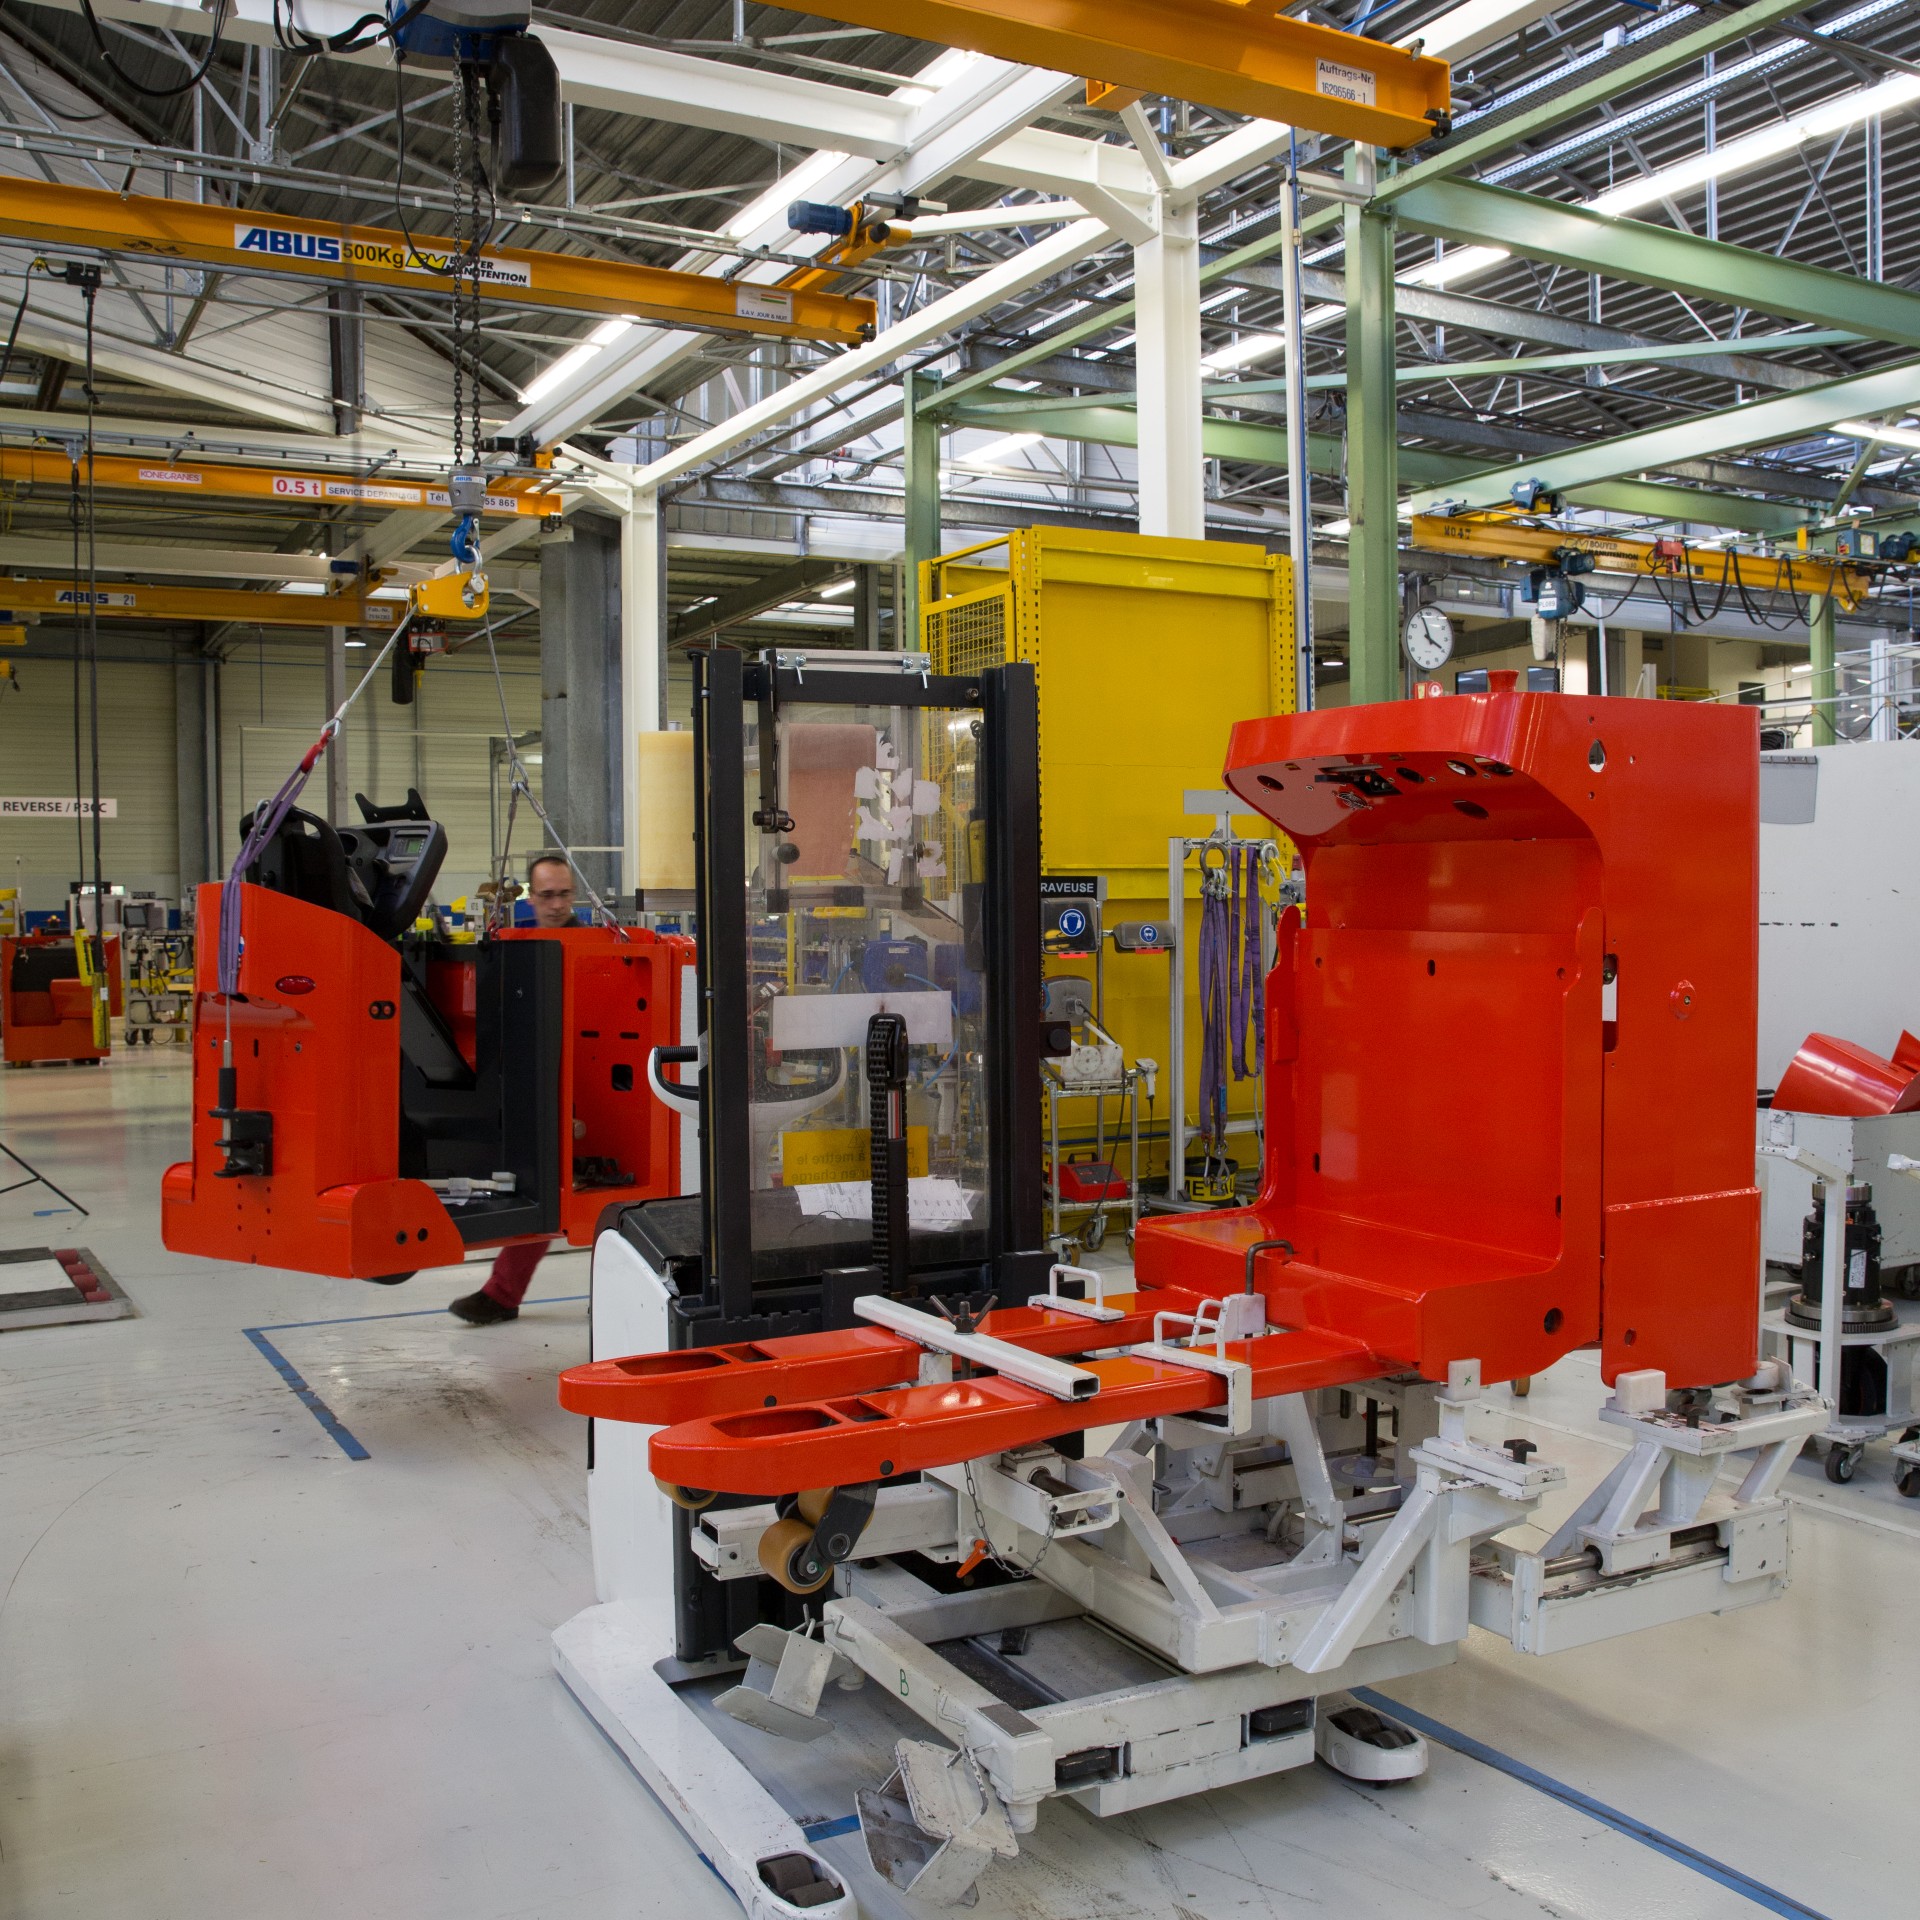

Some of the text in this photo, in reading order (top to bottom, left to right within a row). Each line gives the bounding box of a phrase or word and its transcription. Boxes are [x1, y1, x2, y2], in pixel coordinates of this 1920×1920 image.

[1319, 62, 1374, 85] Auftrags-Nr.
[239, 228, 340, 261] ABUS
[343, 242, 404, 269] 500Kg
[446, 263, 527, 284] NTENTION
[276, 479, 319, 496] 0.5 t
[328, 486, 365, 498] SERVICE
[499, 499, 516, 508] 865
[3, 801, 62, 812] REVERSE
[74, 803, 107, 813] P3C
